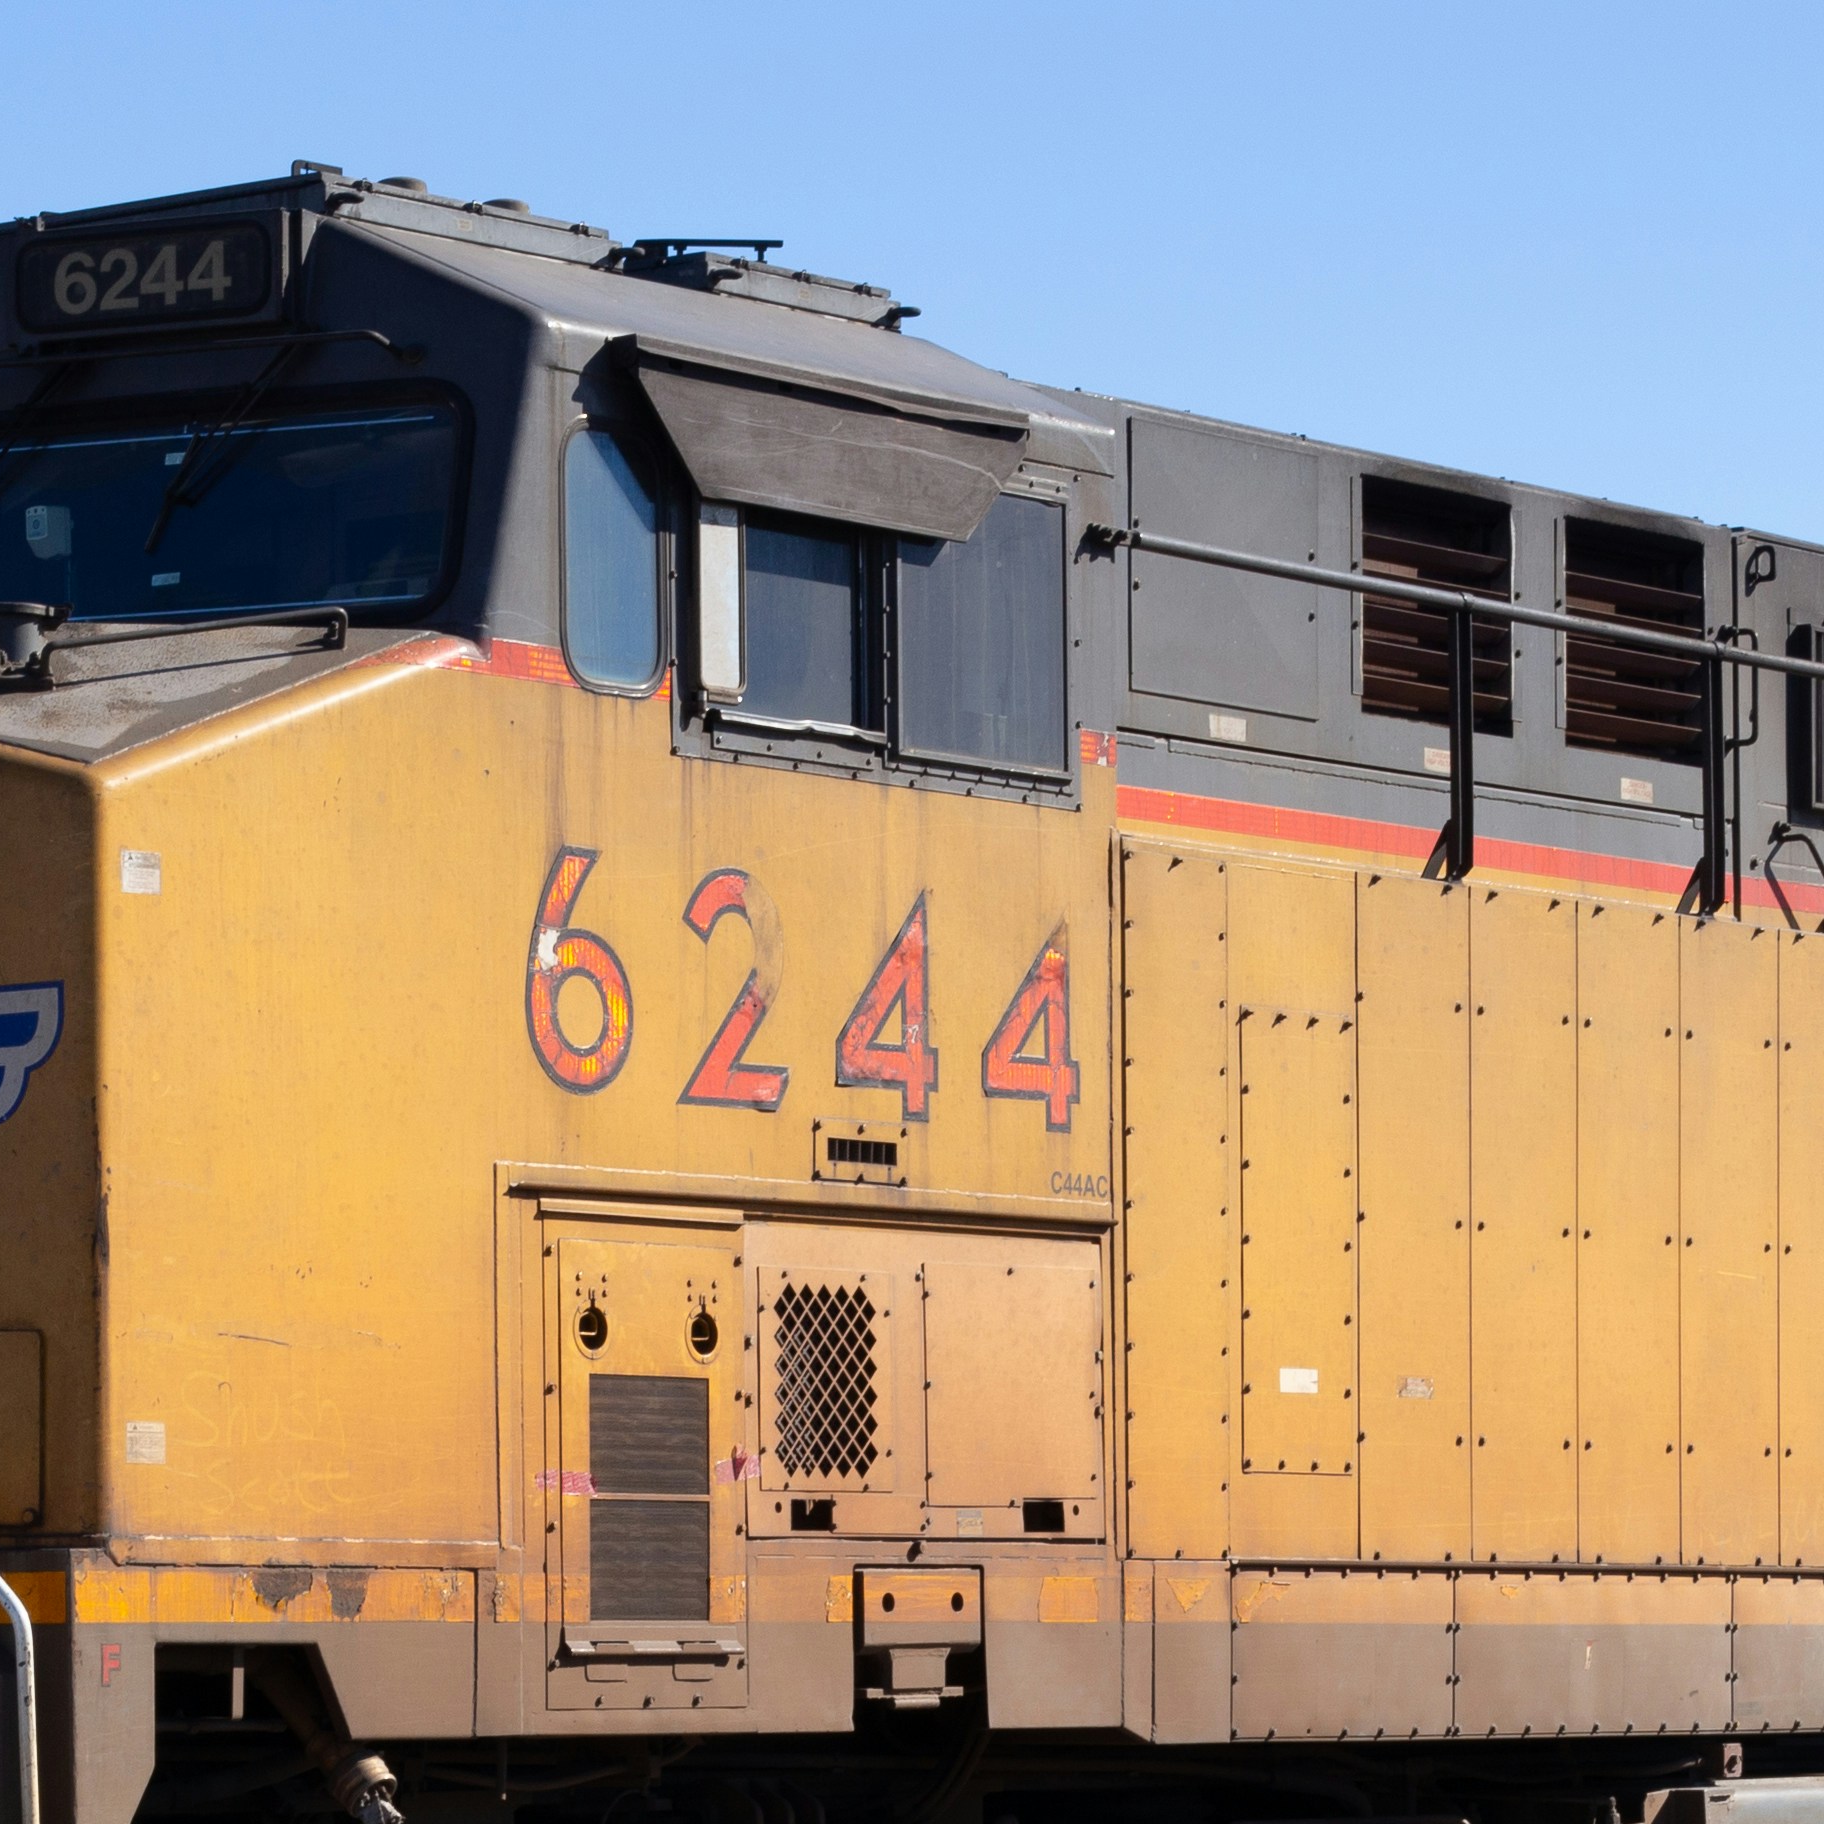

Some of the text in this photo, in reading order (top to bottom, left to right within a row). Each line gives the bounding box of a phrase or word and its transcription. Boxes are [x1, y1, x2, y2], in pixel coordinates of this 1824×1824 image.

[53, 240, 232, 316] 6244
[526, 845, 1080, 1133] 6244
[1049, 1171, 1109, 1199] C44AC
[101, 1643, 122, 1687] F
